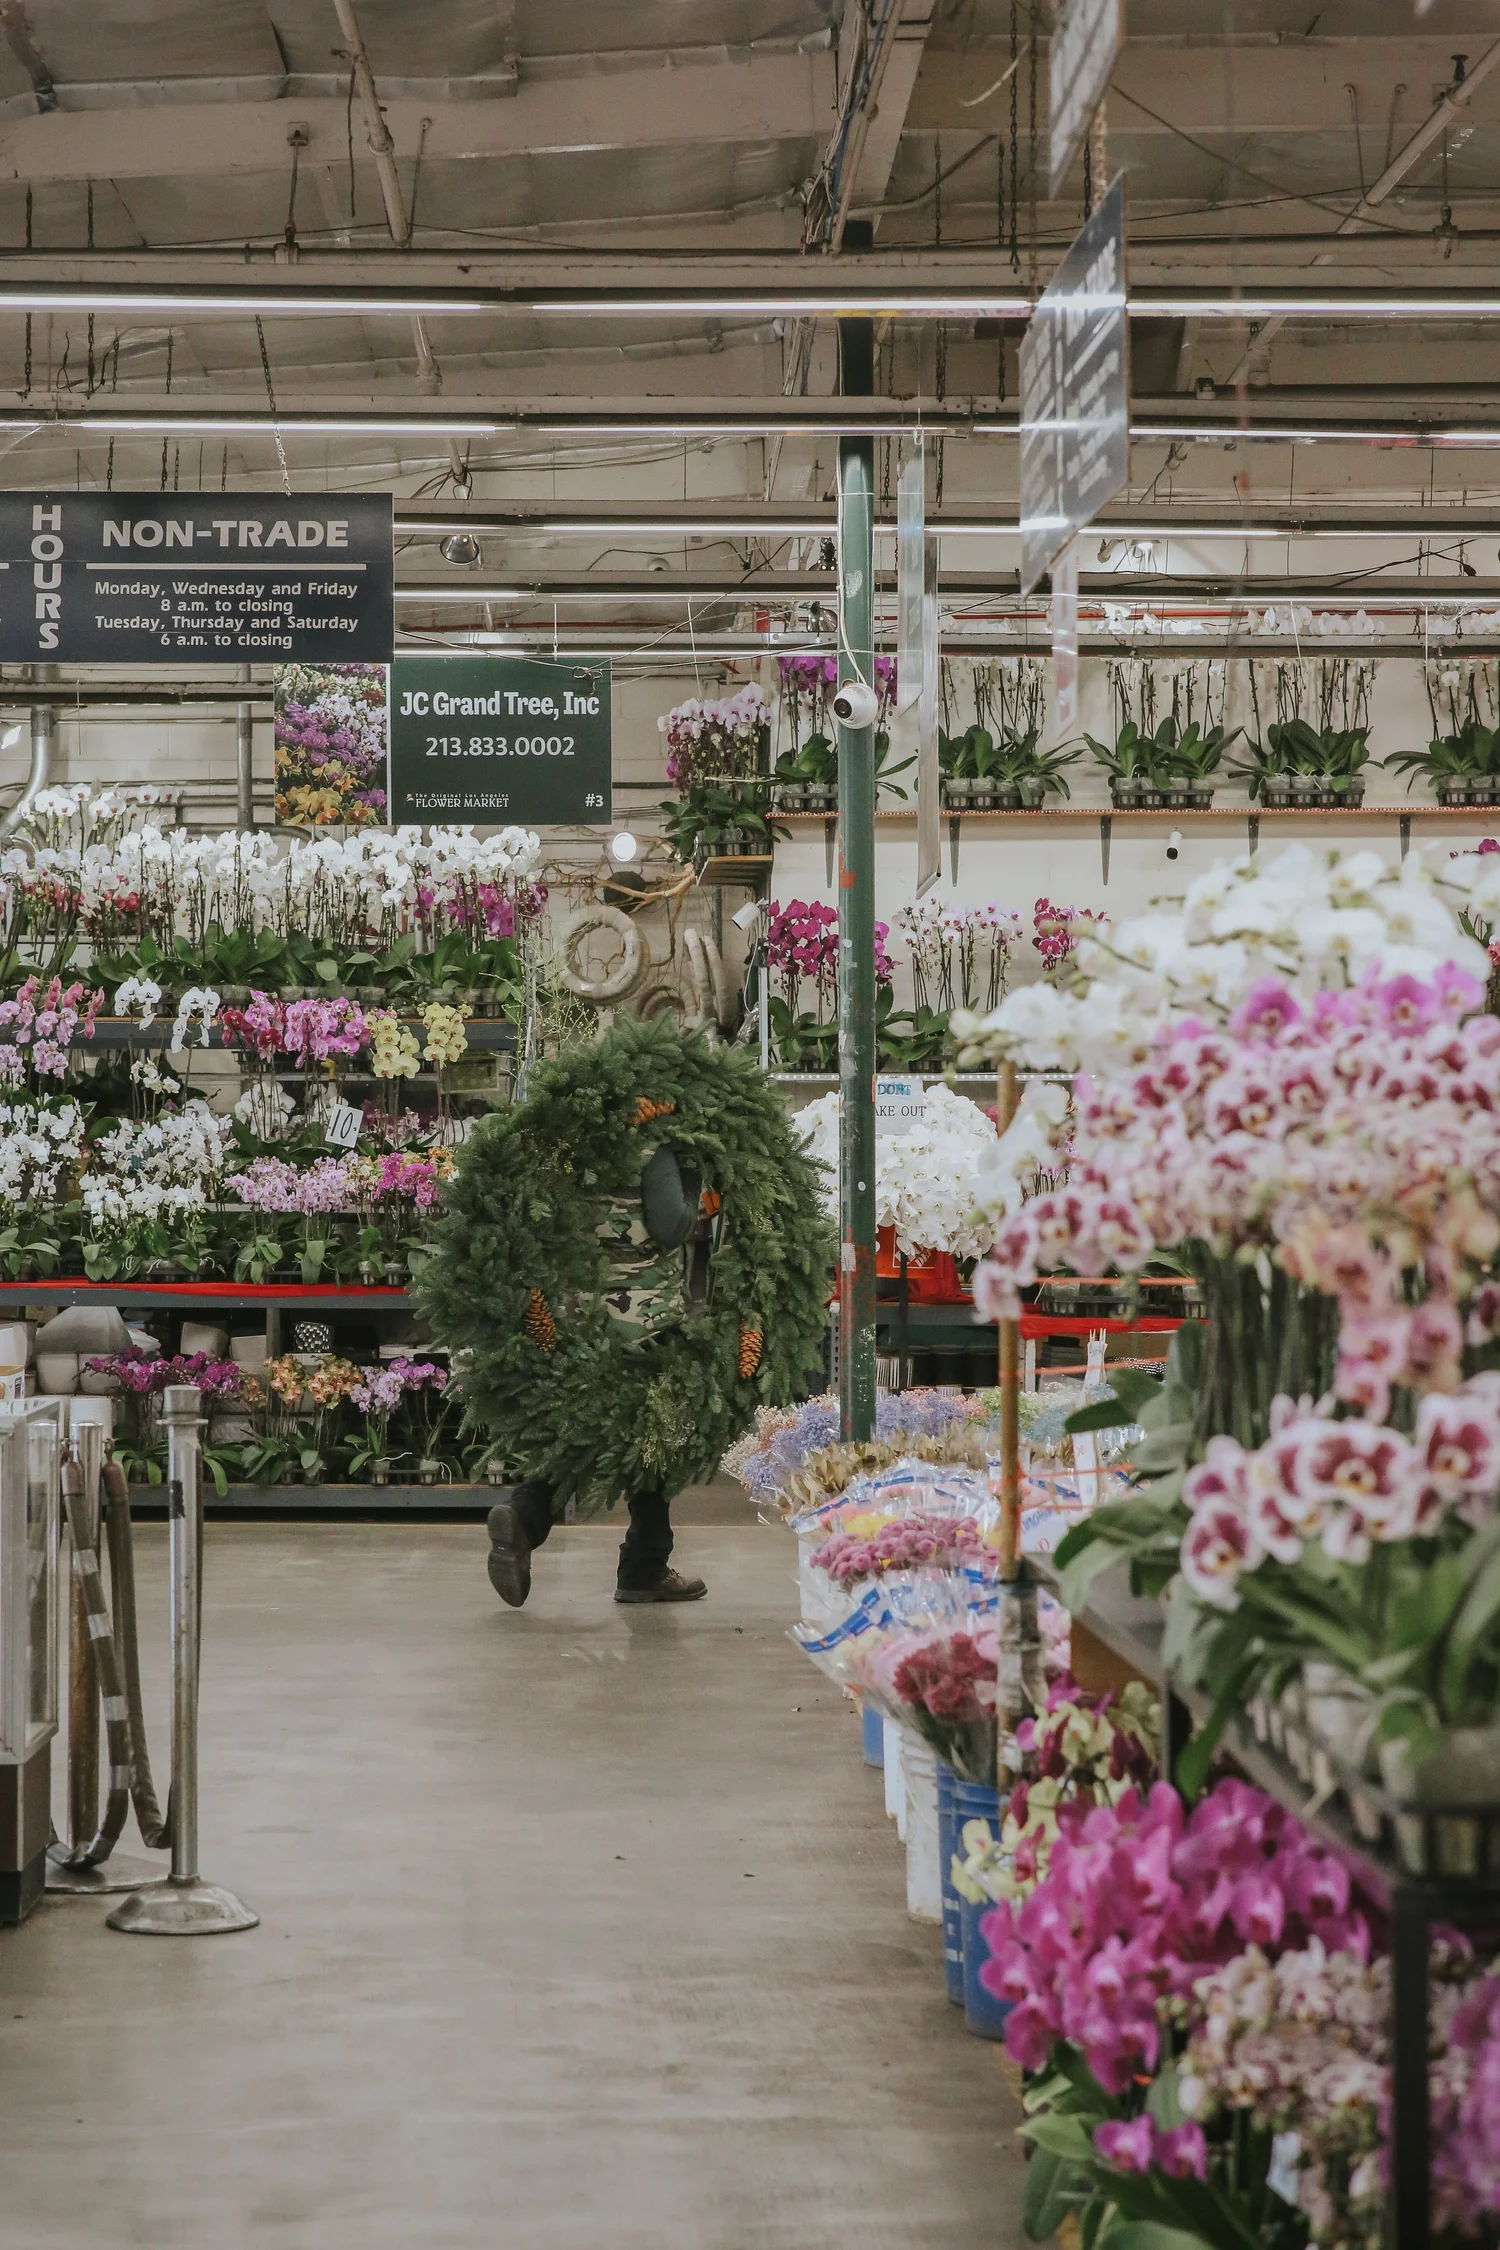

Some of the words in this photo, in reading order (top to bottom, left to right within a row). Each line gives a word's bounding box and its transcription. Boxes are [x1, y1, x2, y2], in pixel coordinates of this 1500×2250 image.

[102, 519, 349, 548] NON-TRADE
[30, 504, 65, 650] HOURS
[94, 581, 166, 598] Monday,
[172, 581, 266, 599] Wednesday
[271, 582, 302, 595] and
[308, 582, 358, 599] Friday
[160, 599, 171, 612] 8
[177, 601, 209, 612] a.m.
[214, 600, 232, 612] to
[238, 599, 293, 615] closing
[94, 615, 166, 632] Tuesday,
[172, 615, 245, 633] Thursday
[250, 616, 283, 630] and
[287, 616, 359, 633] Saturday
[160, 633, 170, 646] 6
[176, 635, 208, 646] a.m.
[213, 634, 231, 646] to
[237, 633, 293, 650] closing
[400, 691, 430, 716] JC
[433, 690, 501, 716] Grand
[503, 691, 559, 722] Tree,
[562, 691, 600, 716] Inc
[425, 736, 575, 757] 213.833.0002
[415, 798, 461, 808] FLOWER
[463, 798, 510, 808] MARKET
[431, 792, 462, 801] Original
[480, 792, 510, 801] Angeles
[584, 792, 605, 808] #3
[901, 1105, 927, 1117] OUT
